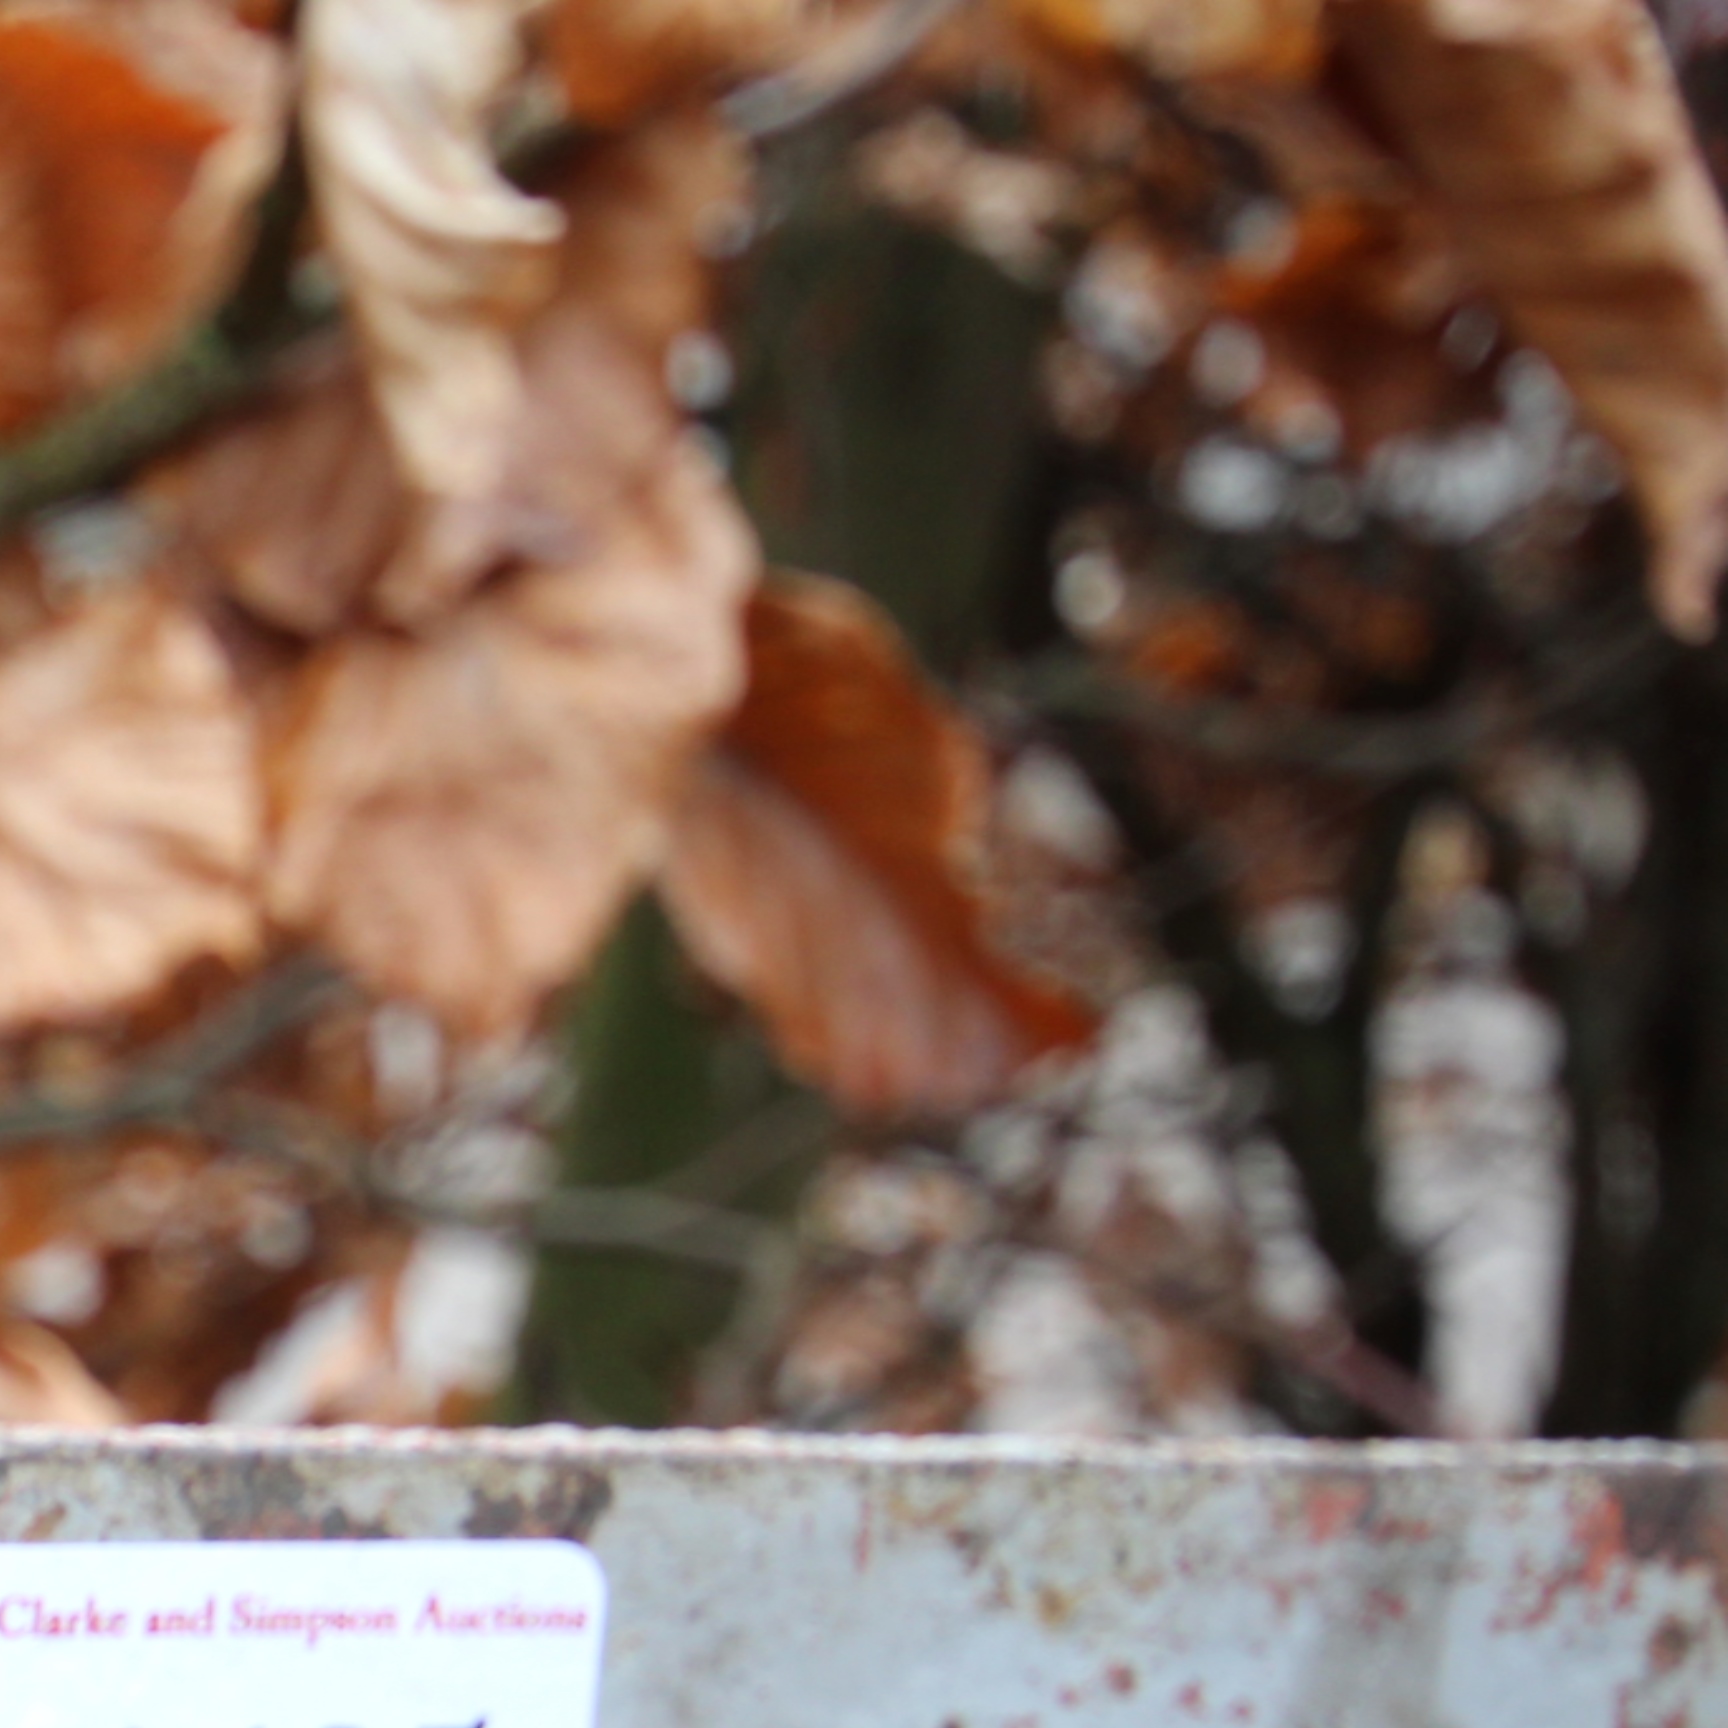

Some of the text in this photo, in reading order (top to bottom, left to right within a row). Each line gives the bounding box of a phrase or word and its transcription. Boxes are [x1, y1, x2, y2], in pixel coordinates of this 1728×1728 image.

[145, 1599, 215, 1636] and
[229, 1599, 399, 1649] Simpson
[418, 1596, 588, 1635] Auctions
